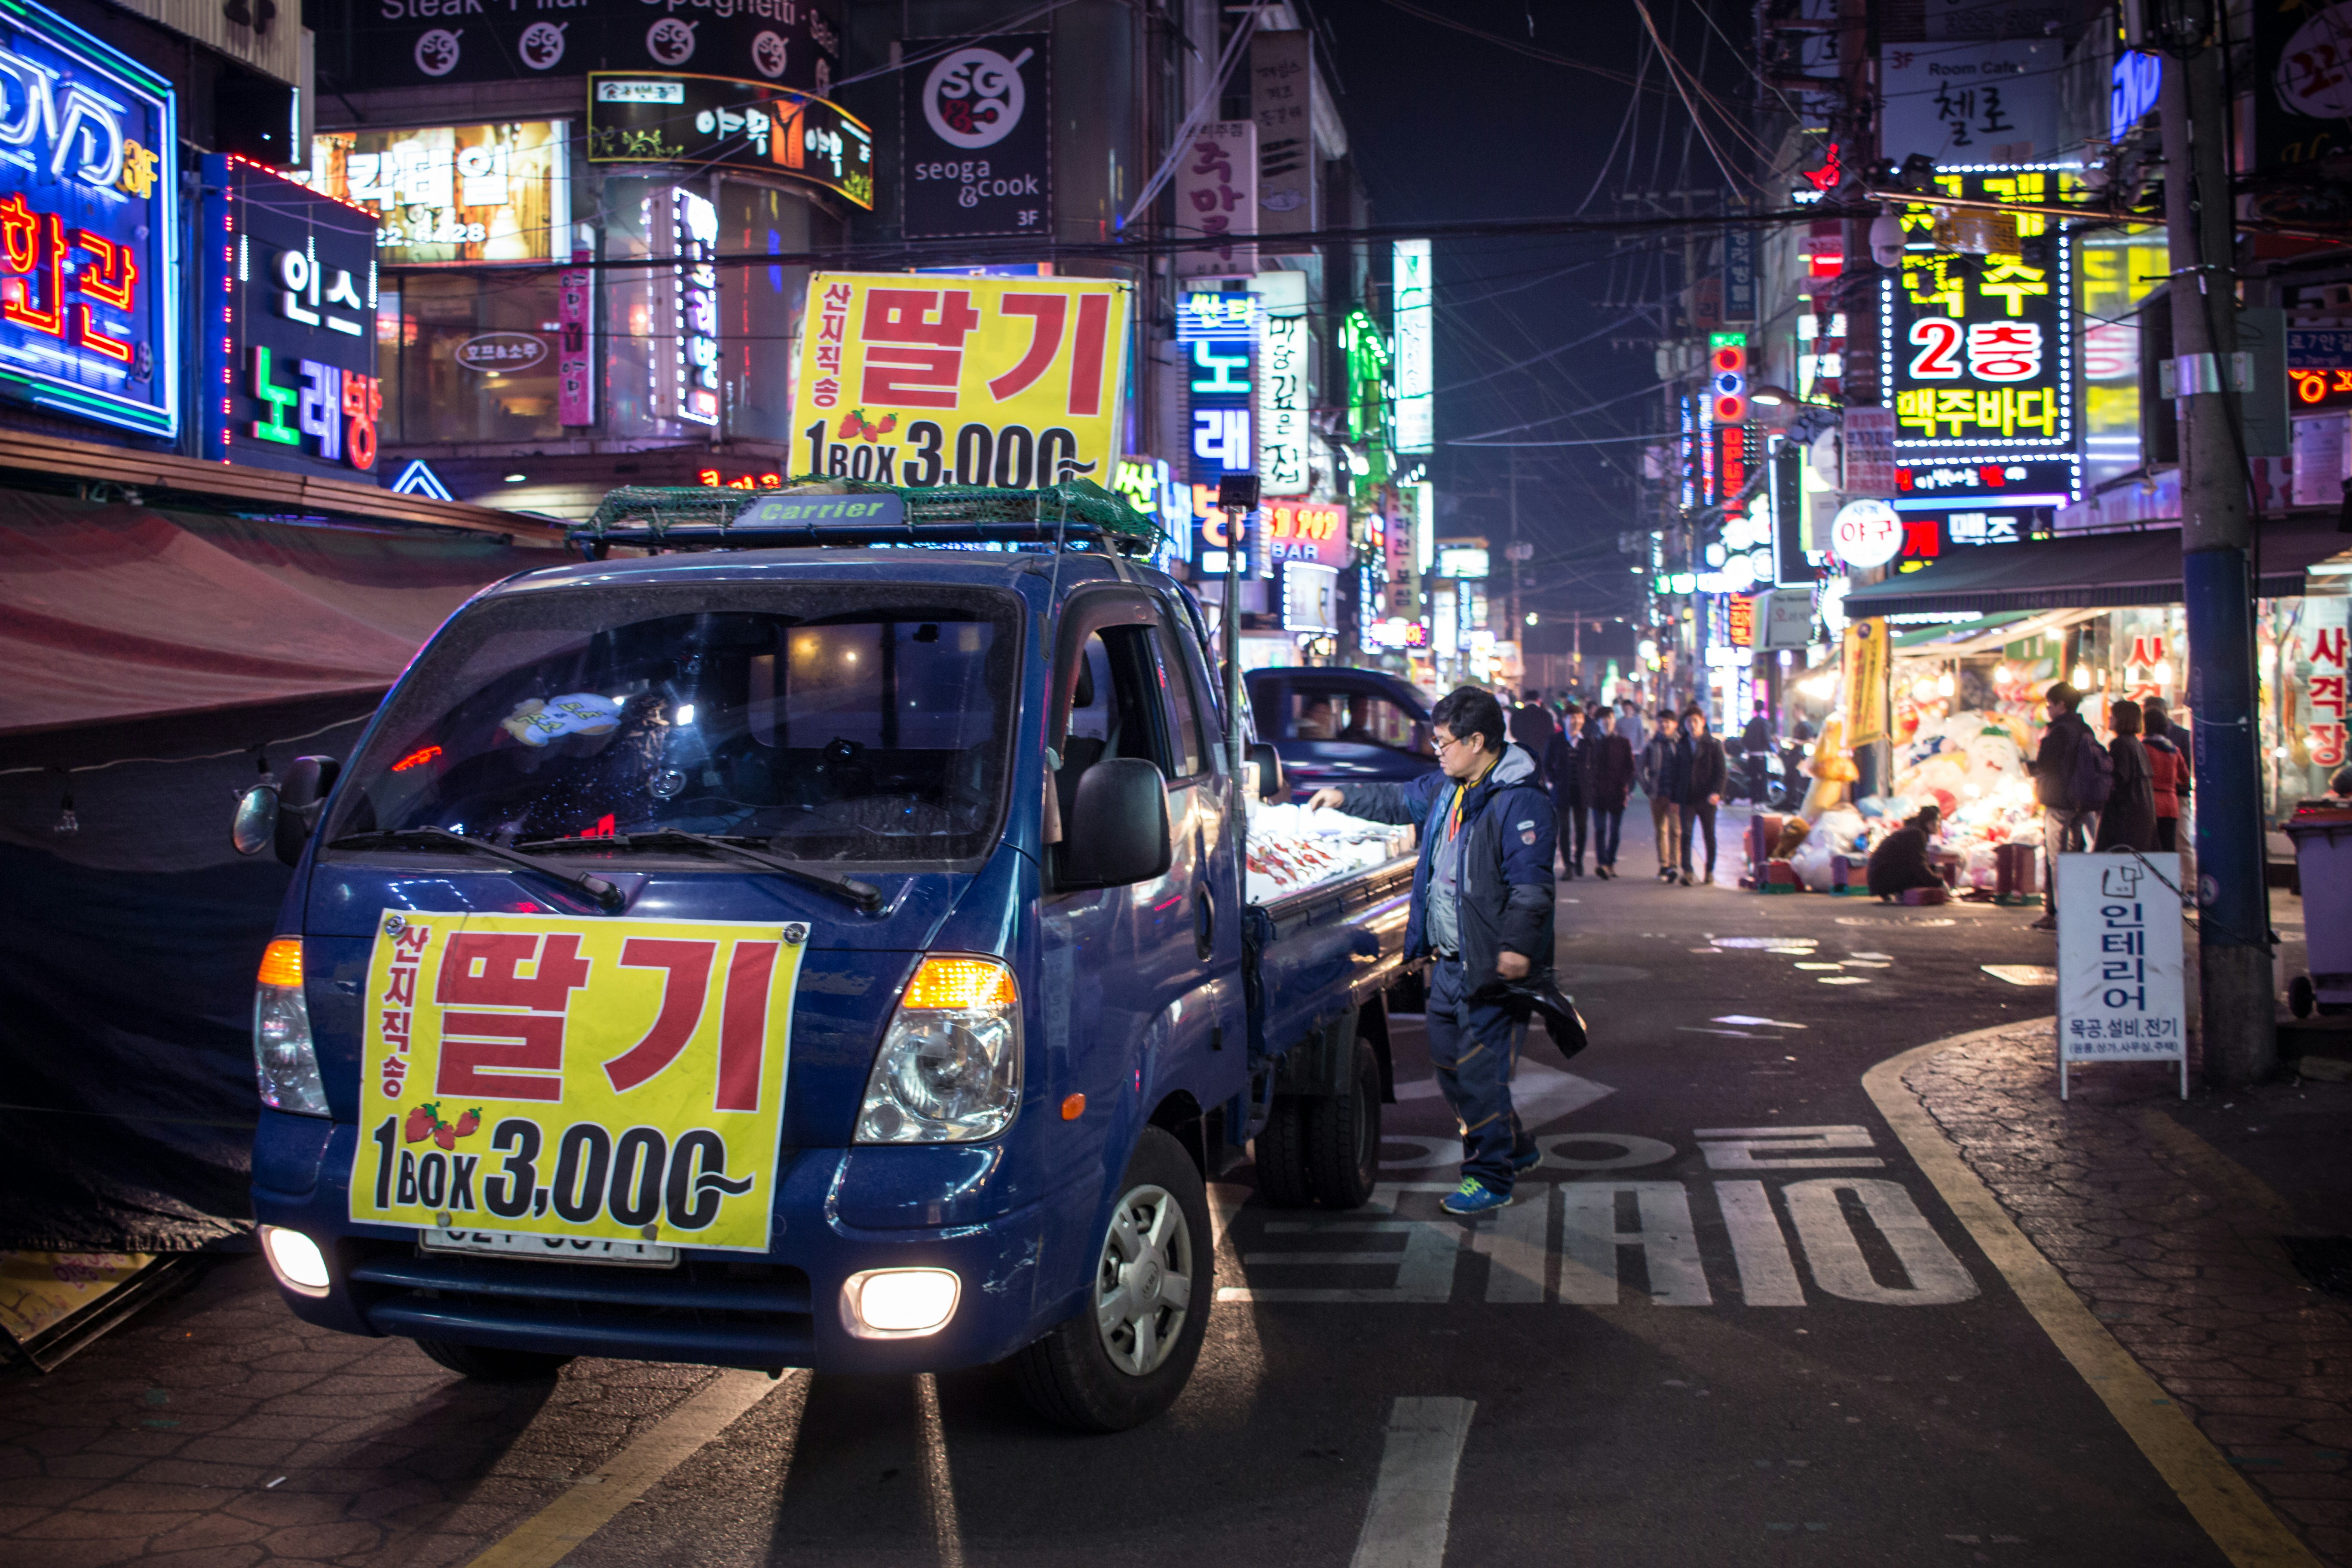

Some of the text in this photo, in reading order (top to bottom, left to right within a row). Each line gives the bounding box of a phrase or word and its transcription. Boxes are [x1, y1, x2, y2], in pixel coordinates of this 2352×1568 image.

[1929, 62, 1976, 75] Room
[346, 145, 509, 211] 칵테일
[915, 160, 990, 183] seoga
[1017, 210, 1039, 226] 3F
[466, 343, 538, 361] 호프&소주
[813, 282, 852, 409] 산지직송
[860, 288, 1112, 416] 딸기
[1908, 317, 2043, 382] 2층
[255, 345, 383, 470] 노래방
[1896, 388, 2059, 437] 맥주바다
[760, 501, 886, 521] Carrier
[1841, 520, 1893, 541] 야구
[1271, 542, 1318, 560] BAR
[2308, 628, 2348, 767] 사격장
[2100, 903, 2145, 1011] 인테리어
[380, 925, 431, 1100] 산지직송
[433, 930, 781, 1113] 딸기
